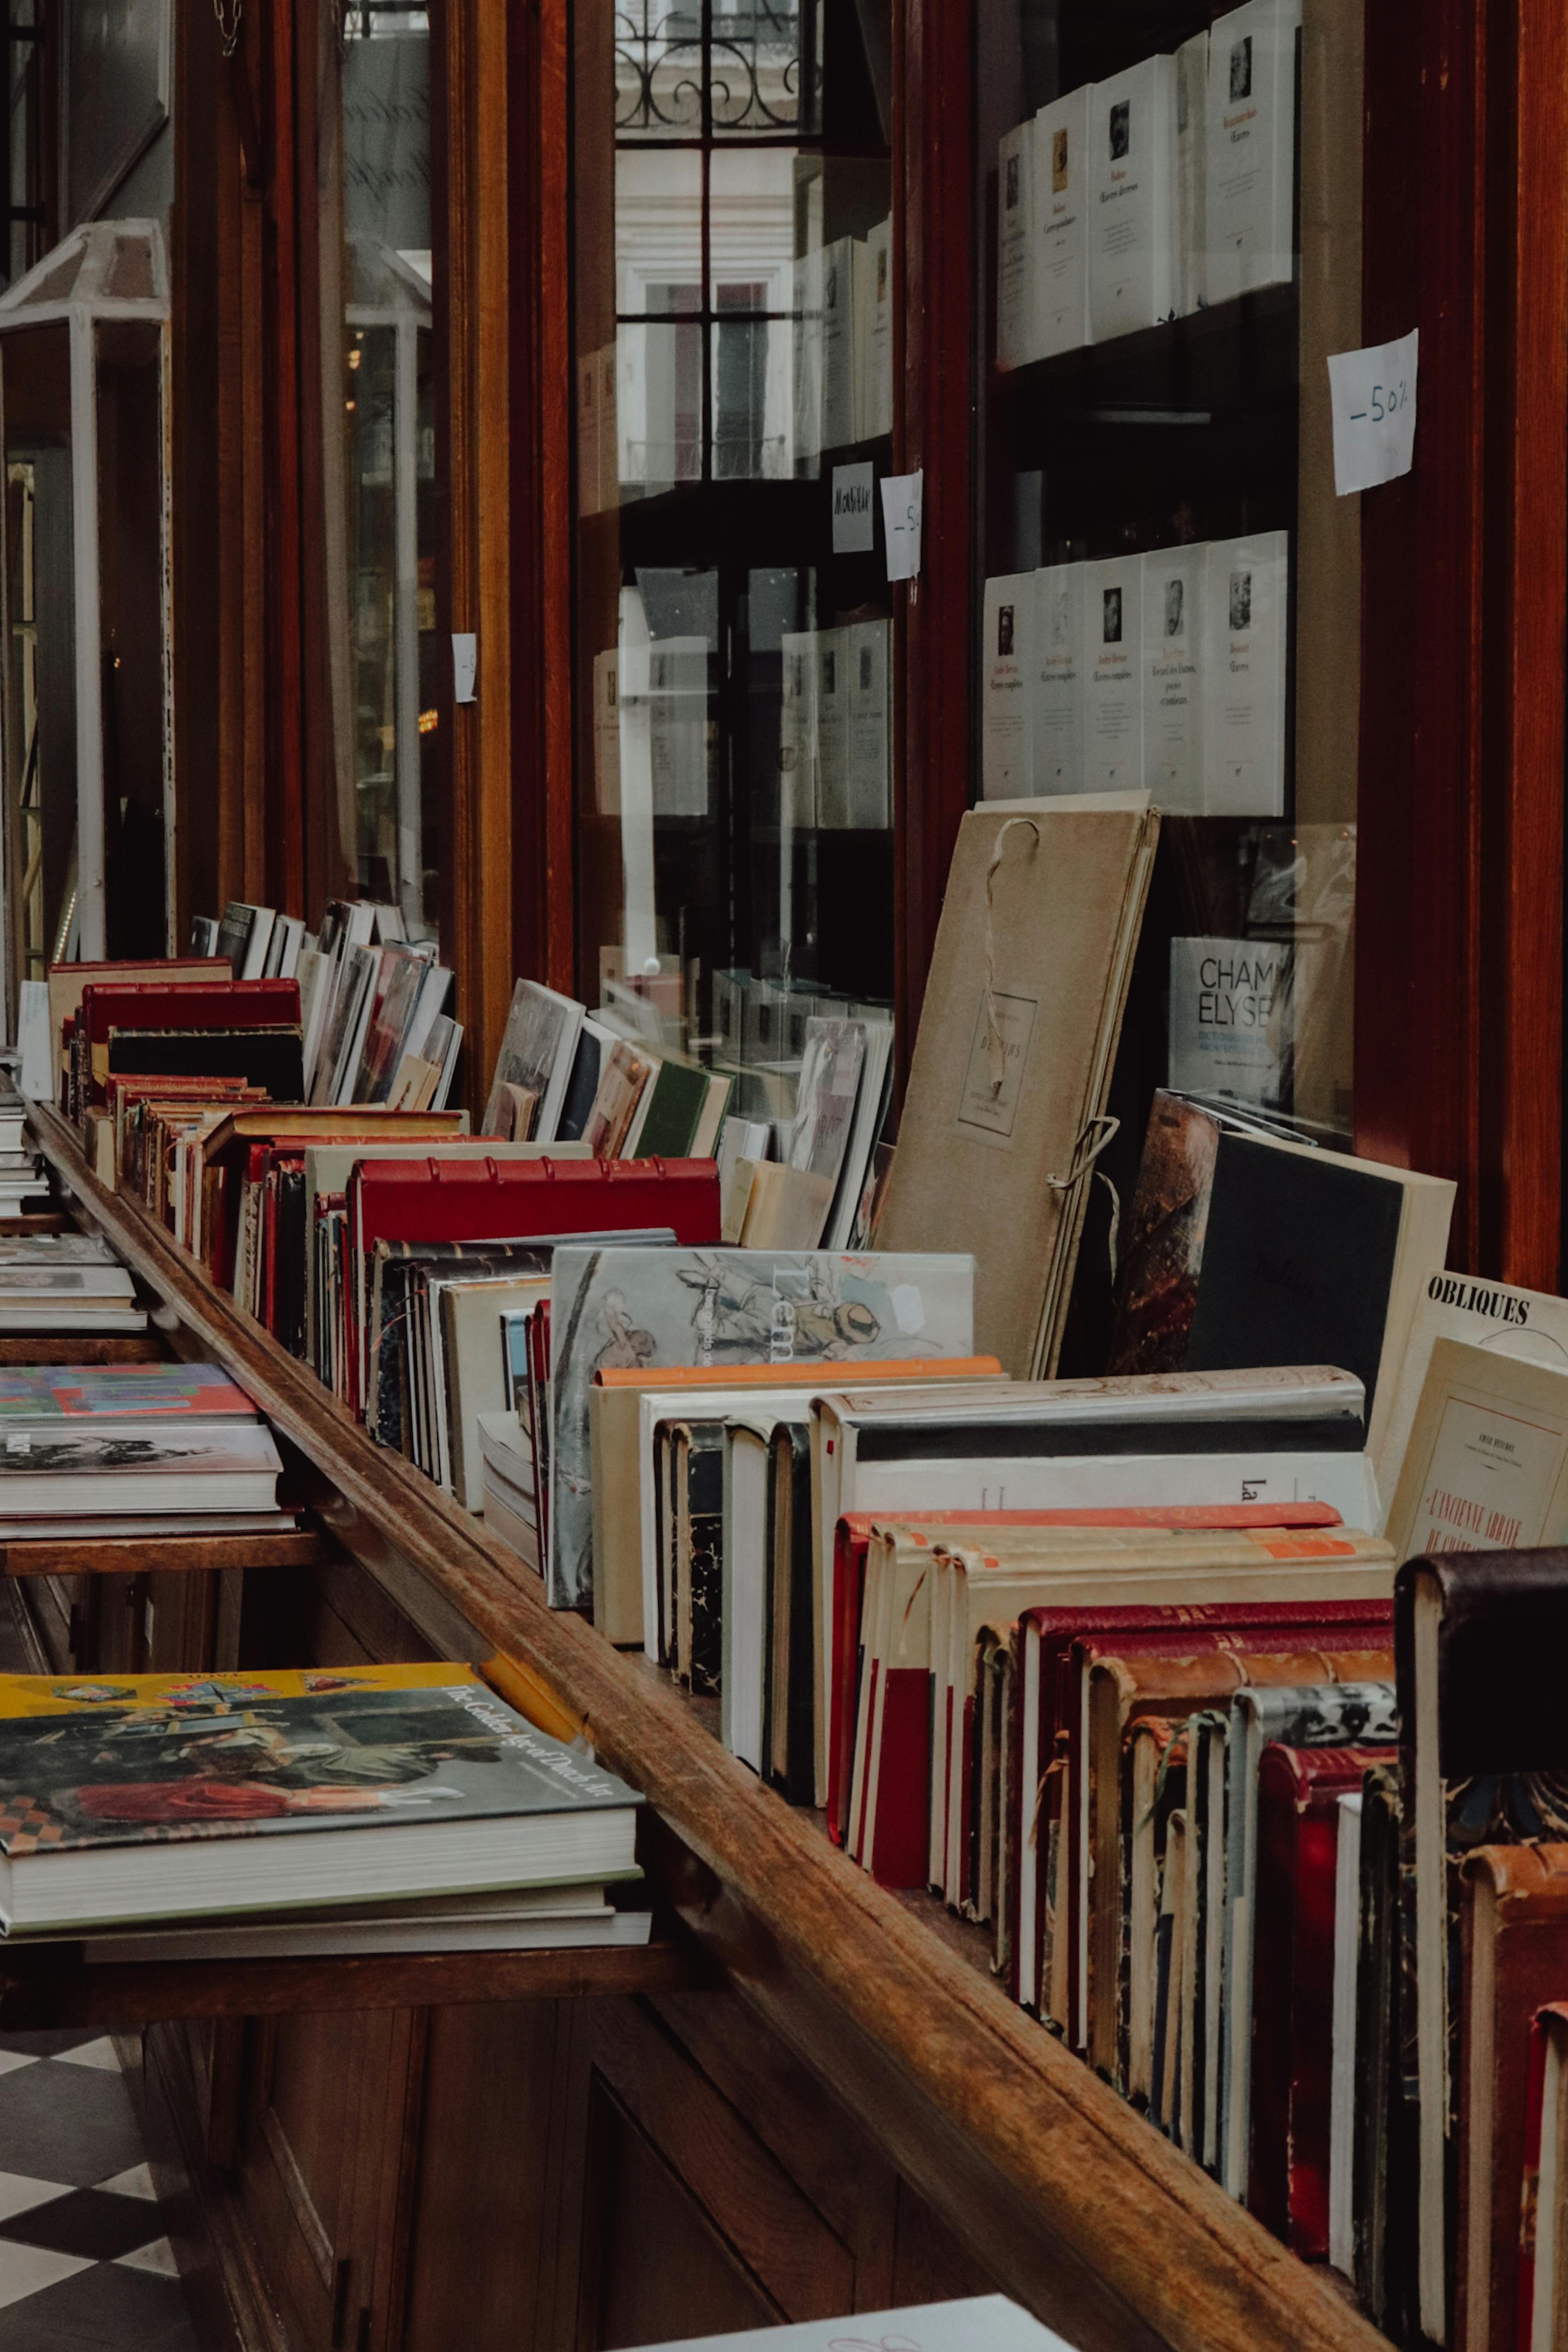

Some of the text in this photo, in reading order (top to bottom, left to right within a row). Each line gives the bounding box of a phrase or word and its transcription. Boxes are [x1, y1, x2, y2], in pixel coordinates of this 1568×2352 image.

[1350, 381, 1408, 421] -50%
[1427, 1275, 1530, 1326] OBLIQUES
[441, 1685, 476, 1702] The
[464, 1701, 512, 1734] Golden
[526, 1748, 565, 1758] of
[539, 1756, 598, 1783] Dutch
[578, 1783, 614, 1797] Art
